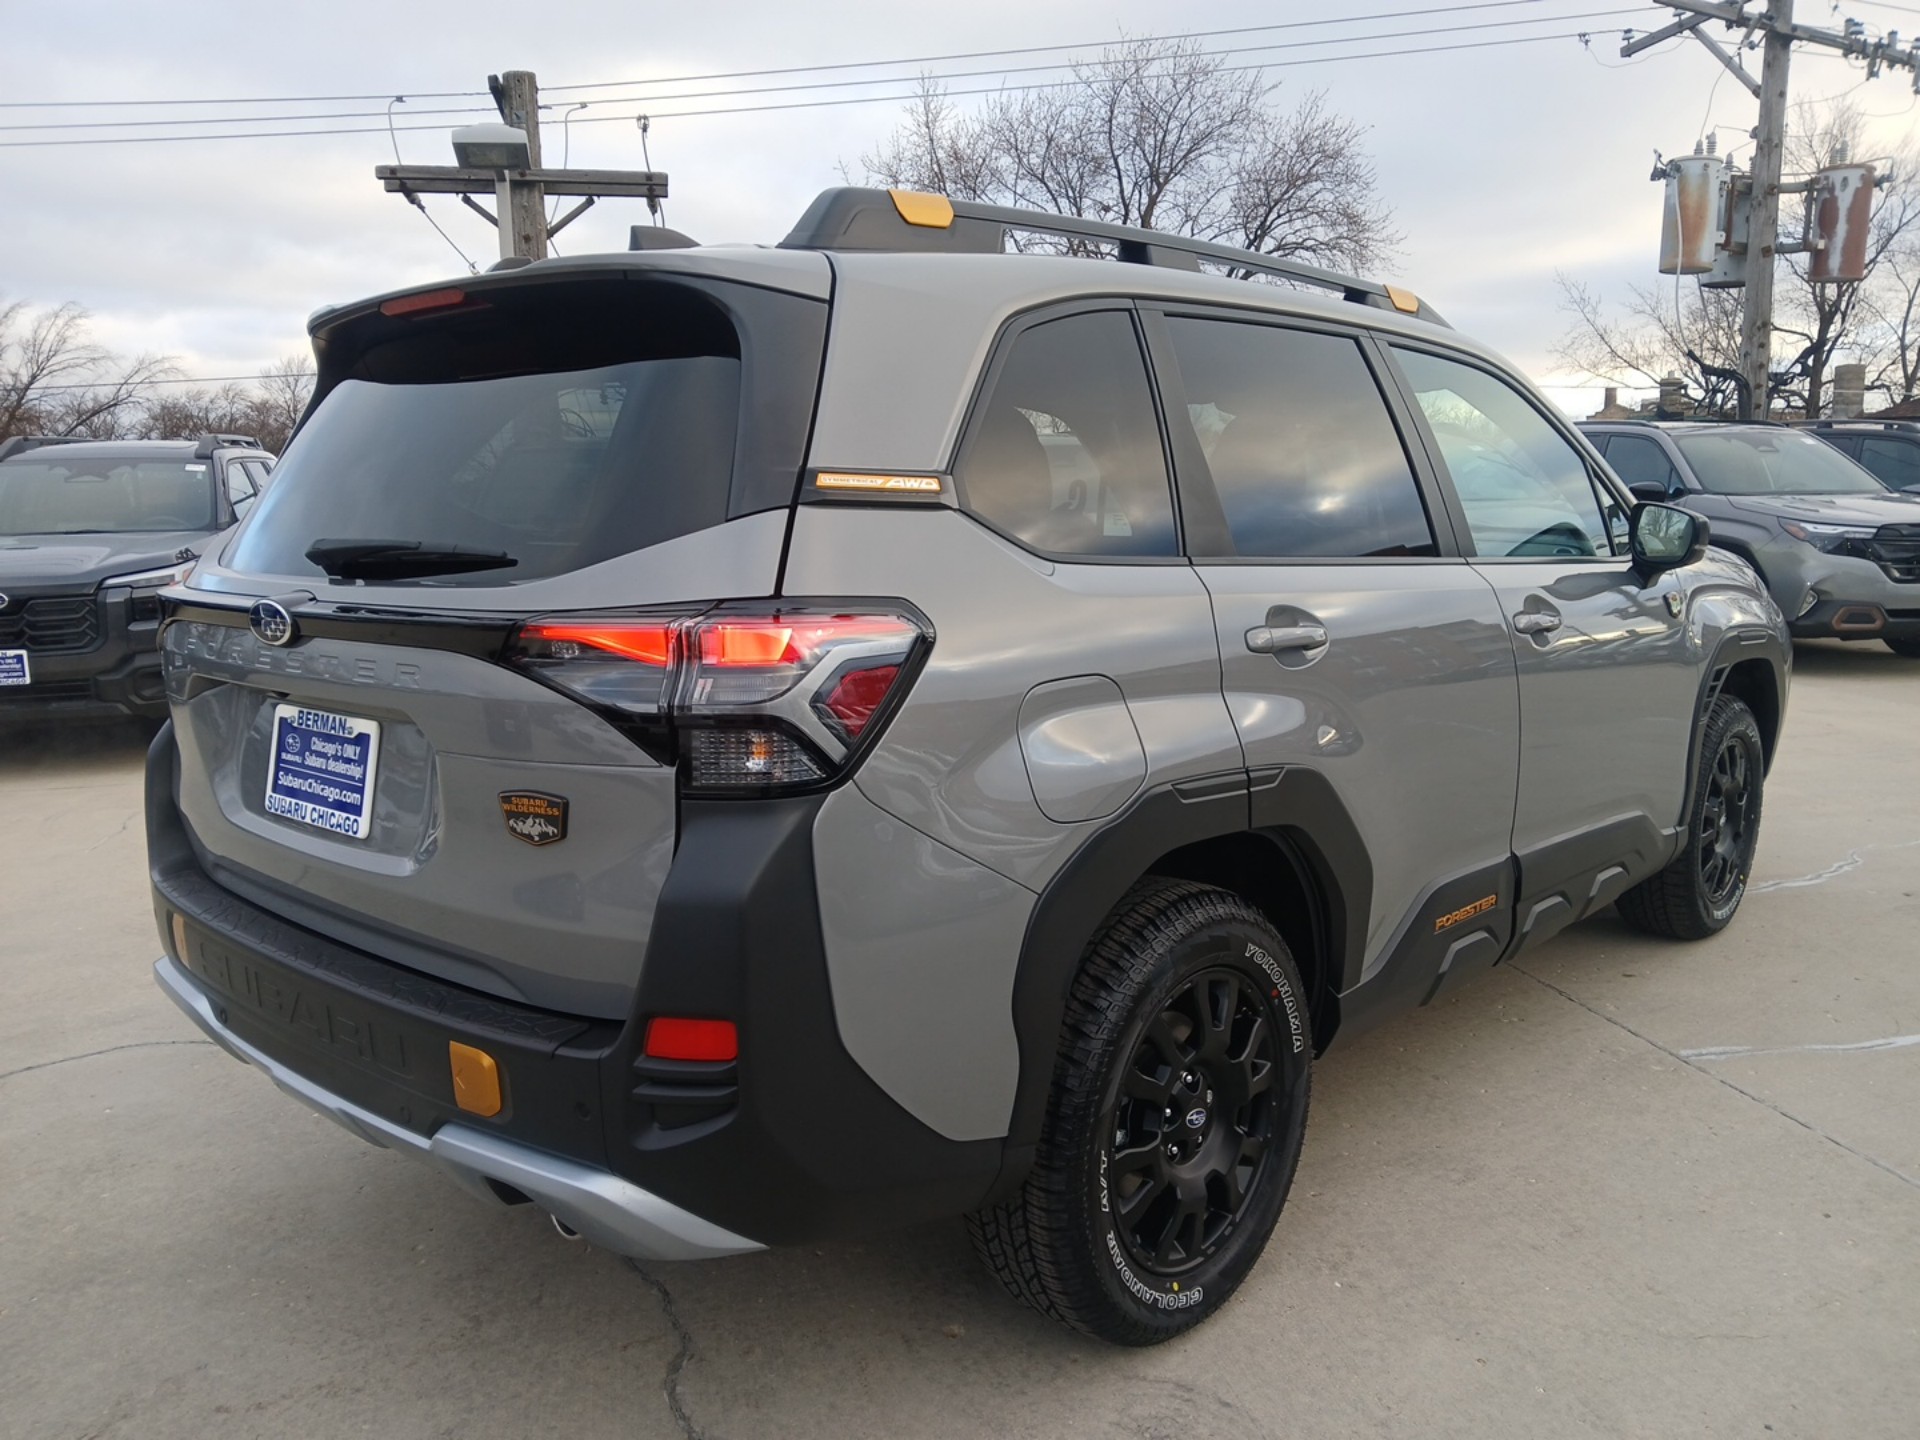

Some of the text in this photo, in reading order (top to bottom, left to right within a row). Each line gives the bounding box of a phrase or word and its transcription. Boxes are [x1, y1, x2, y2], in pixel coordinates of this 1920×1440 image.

[885, 478, 941, 490] AWD
[186, 636, 421, 689] FORESTER
[297, 709, 347, 735] BERMAN
[304, 751, 327, 770] Subaru
[311, 737, 361, 761] Chicago's ONLY
[277, 771, 361, 805] SubaruChicago.com
[511, 797, 547, 807] SUBARU
[266, 794, 359, 836] SUBARU CHICAGO
[503, 803, 559, 815] WILDERNESS
[1435, 894, 1497, 931] FORESTER
[1244, 942, 1304, 1053] YOKOHAMA
[1106, 1230, 1204, 1310] GEOLANDAR
